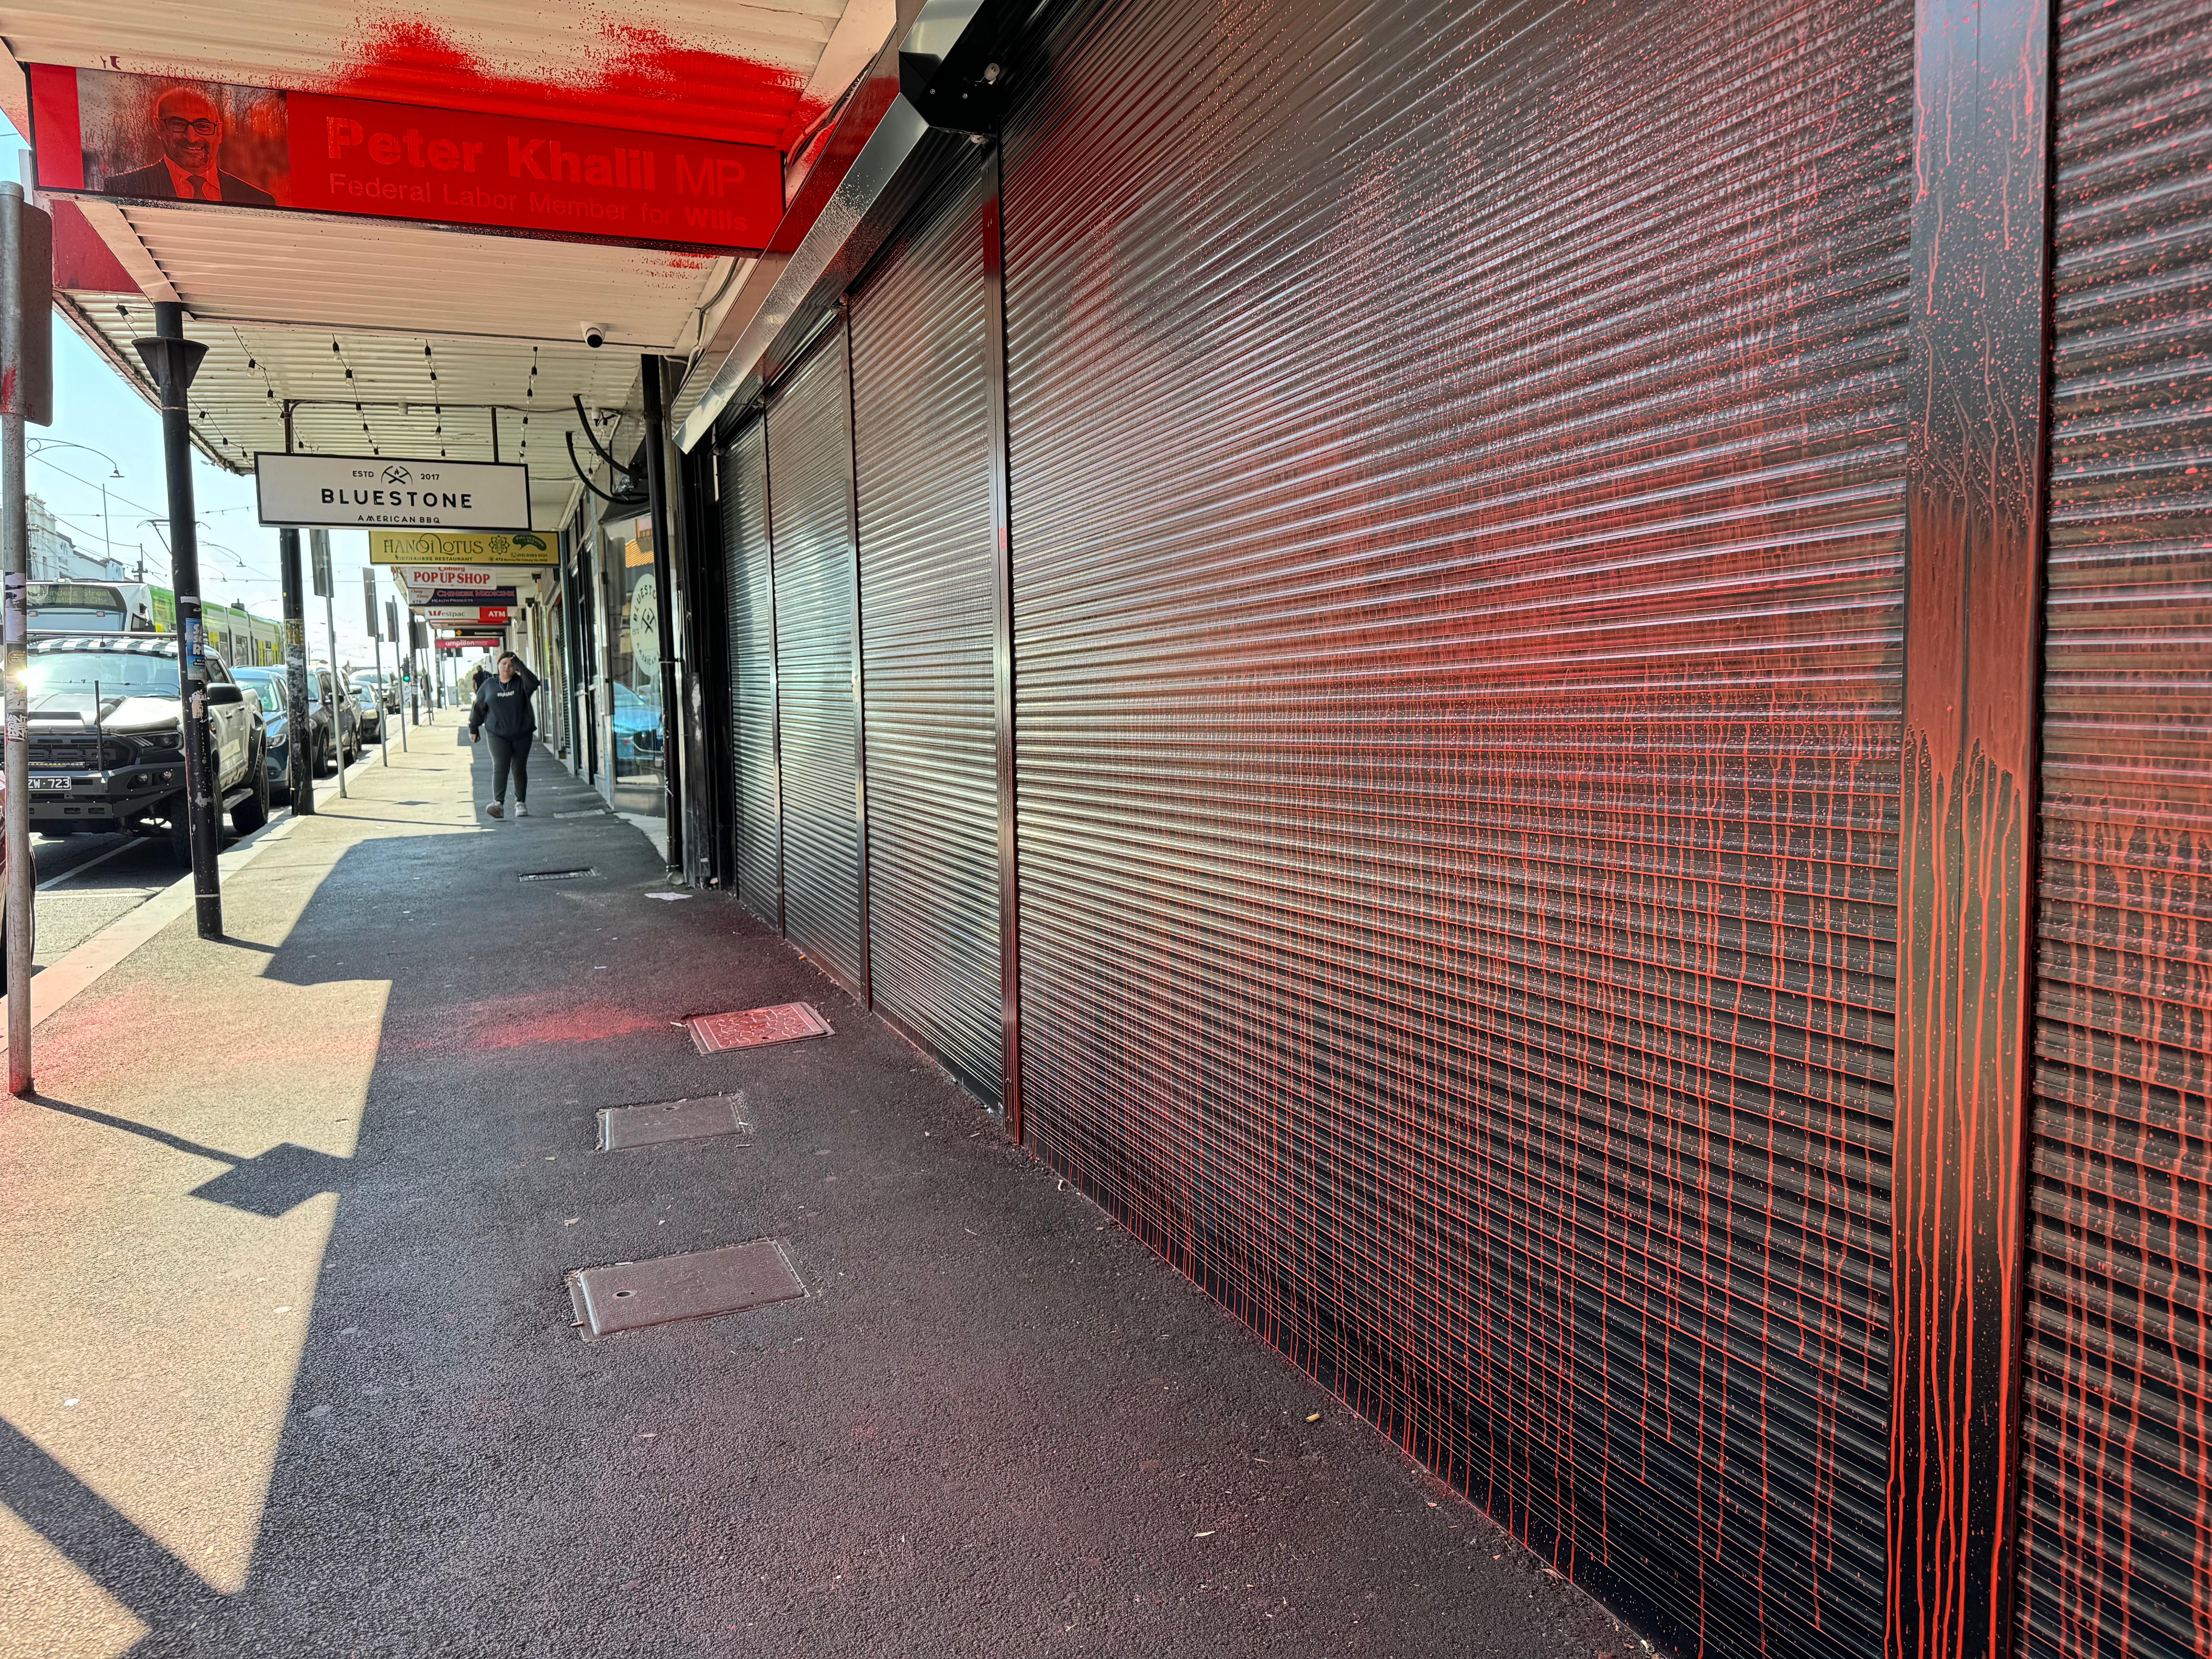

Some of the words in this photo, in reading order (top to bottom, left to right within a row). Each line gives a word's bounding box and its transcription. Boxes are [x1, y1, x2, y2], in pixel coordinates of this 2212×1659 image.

[326, 116, 484, 173] Peter
[507, 136, 656, 190] Khalil
[676, 154, 746, 197] MP
[329, 173, 431, 203] Federal
[443, 184, 517, 210] Labor
[530, 192, 629, 220] Member
[641, 203, 673, 224] for
[684, 207, 749, 232] Wills
[321, 488, 472, 509] BLUESTONE
[357, 514, 416, 522] AMERICAN
[414, 572, 438, 583] POP
[440, 572, 456, 583] UP
[457, 573, 490, 584] SHOP
[48, 778, 70, 789] 723
